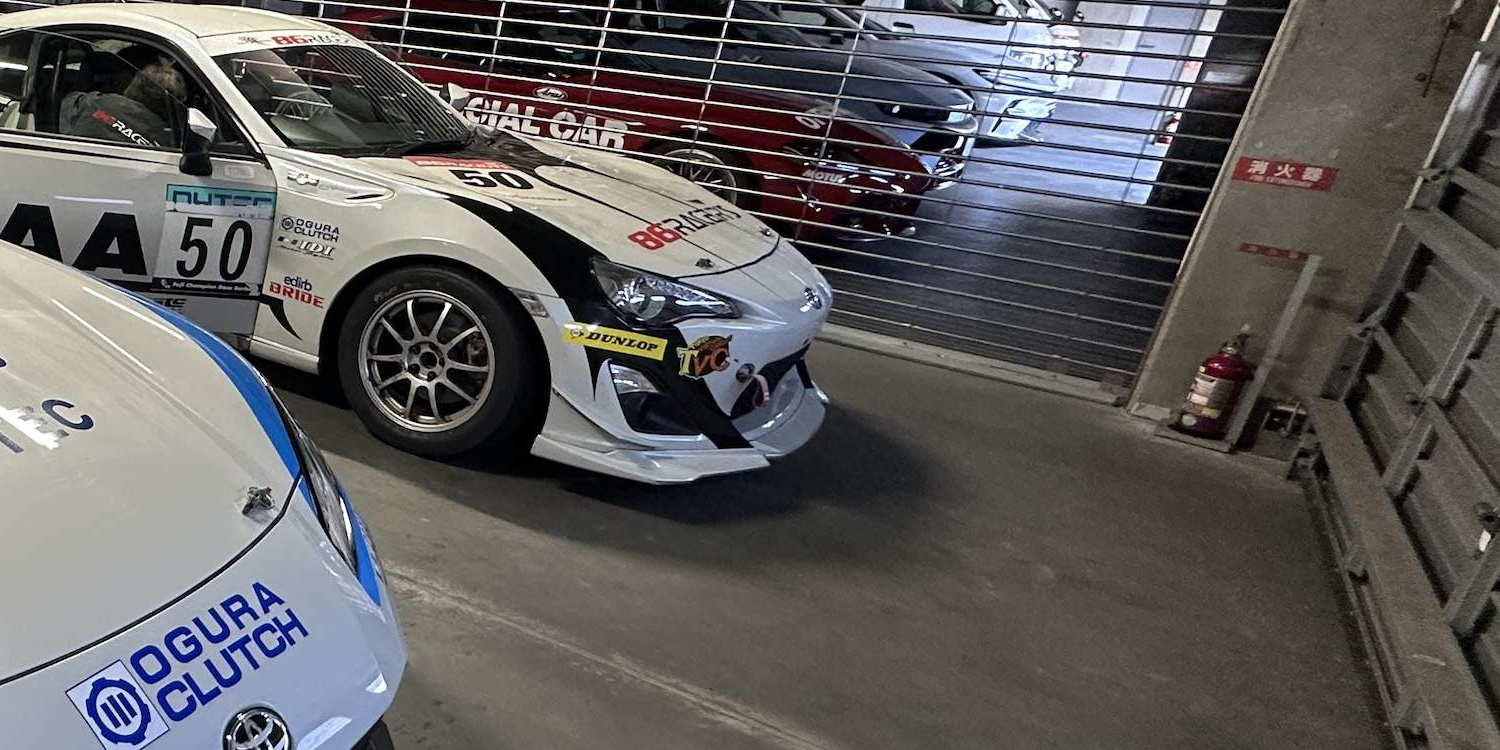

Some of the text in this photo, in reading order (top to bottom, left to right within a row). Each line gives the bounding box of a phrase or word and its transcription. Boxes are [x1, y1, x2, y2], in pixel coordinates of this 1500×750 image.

[449, 170, 534, 189] 50
[294, 226, 339, 242] CLUTCH
[295, 218, 340, 235] OGURA
[176, 216, 253, 281] 50
[269, 281, 325, 309] BRIDE
[586, 331, 659, 351] DUNLOP
[130, 581, 285, 685] OGURA
[156, 608, 309, 722] CLUTCH
